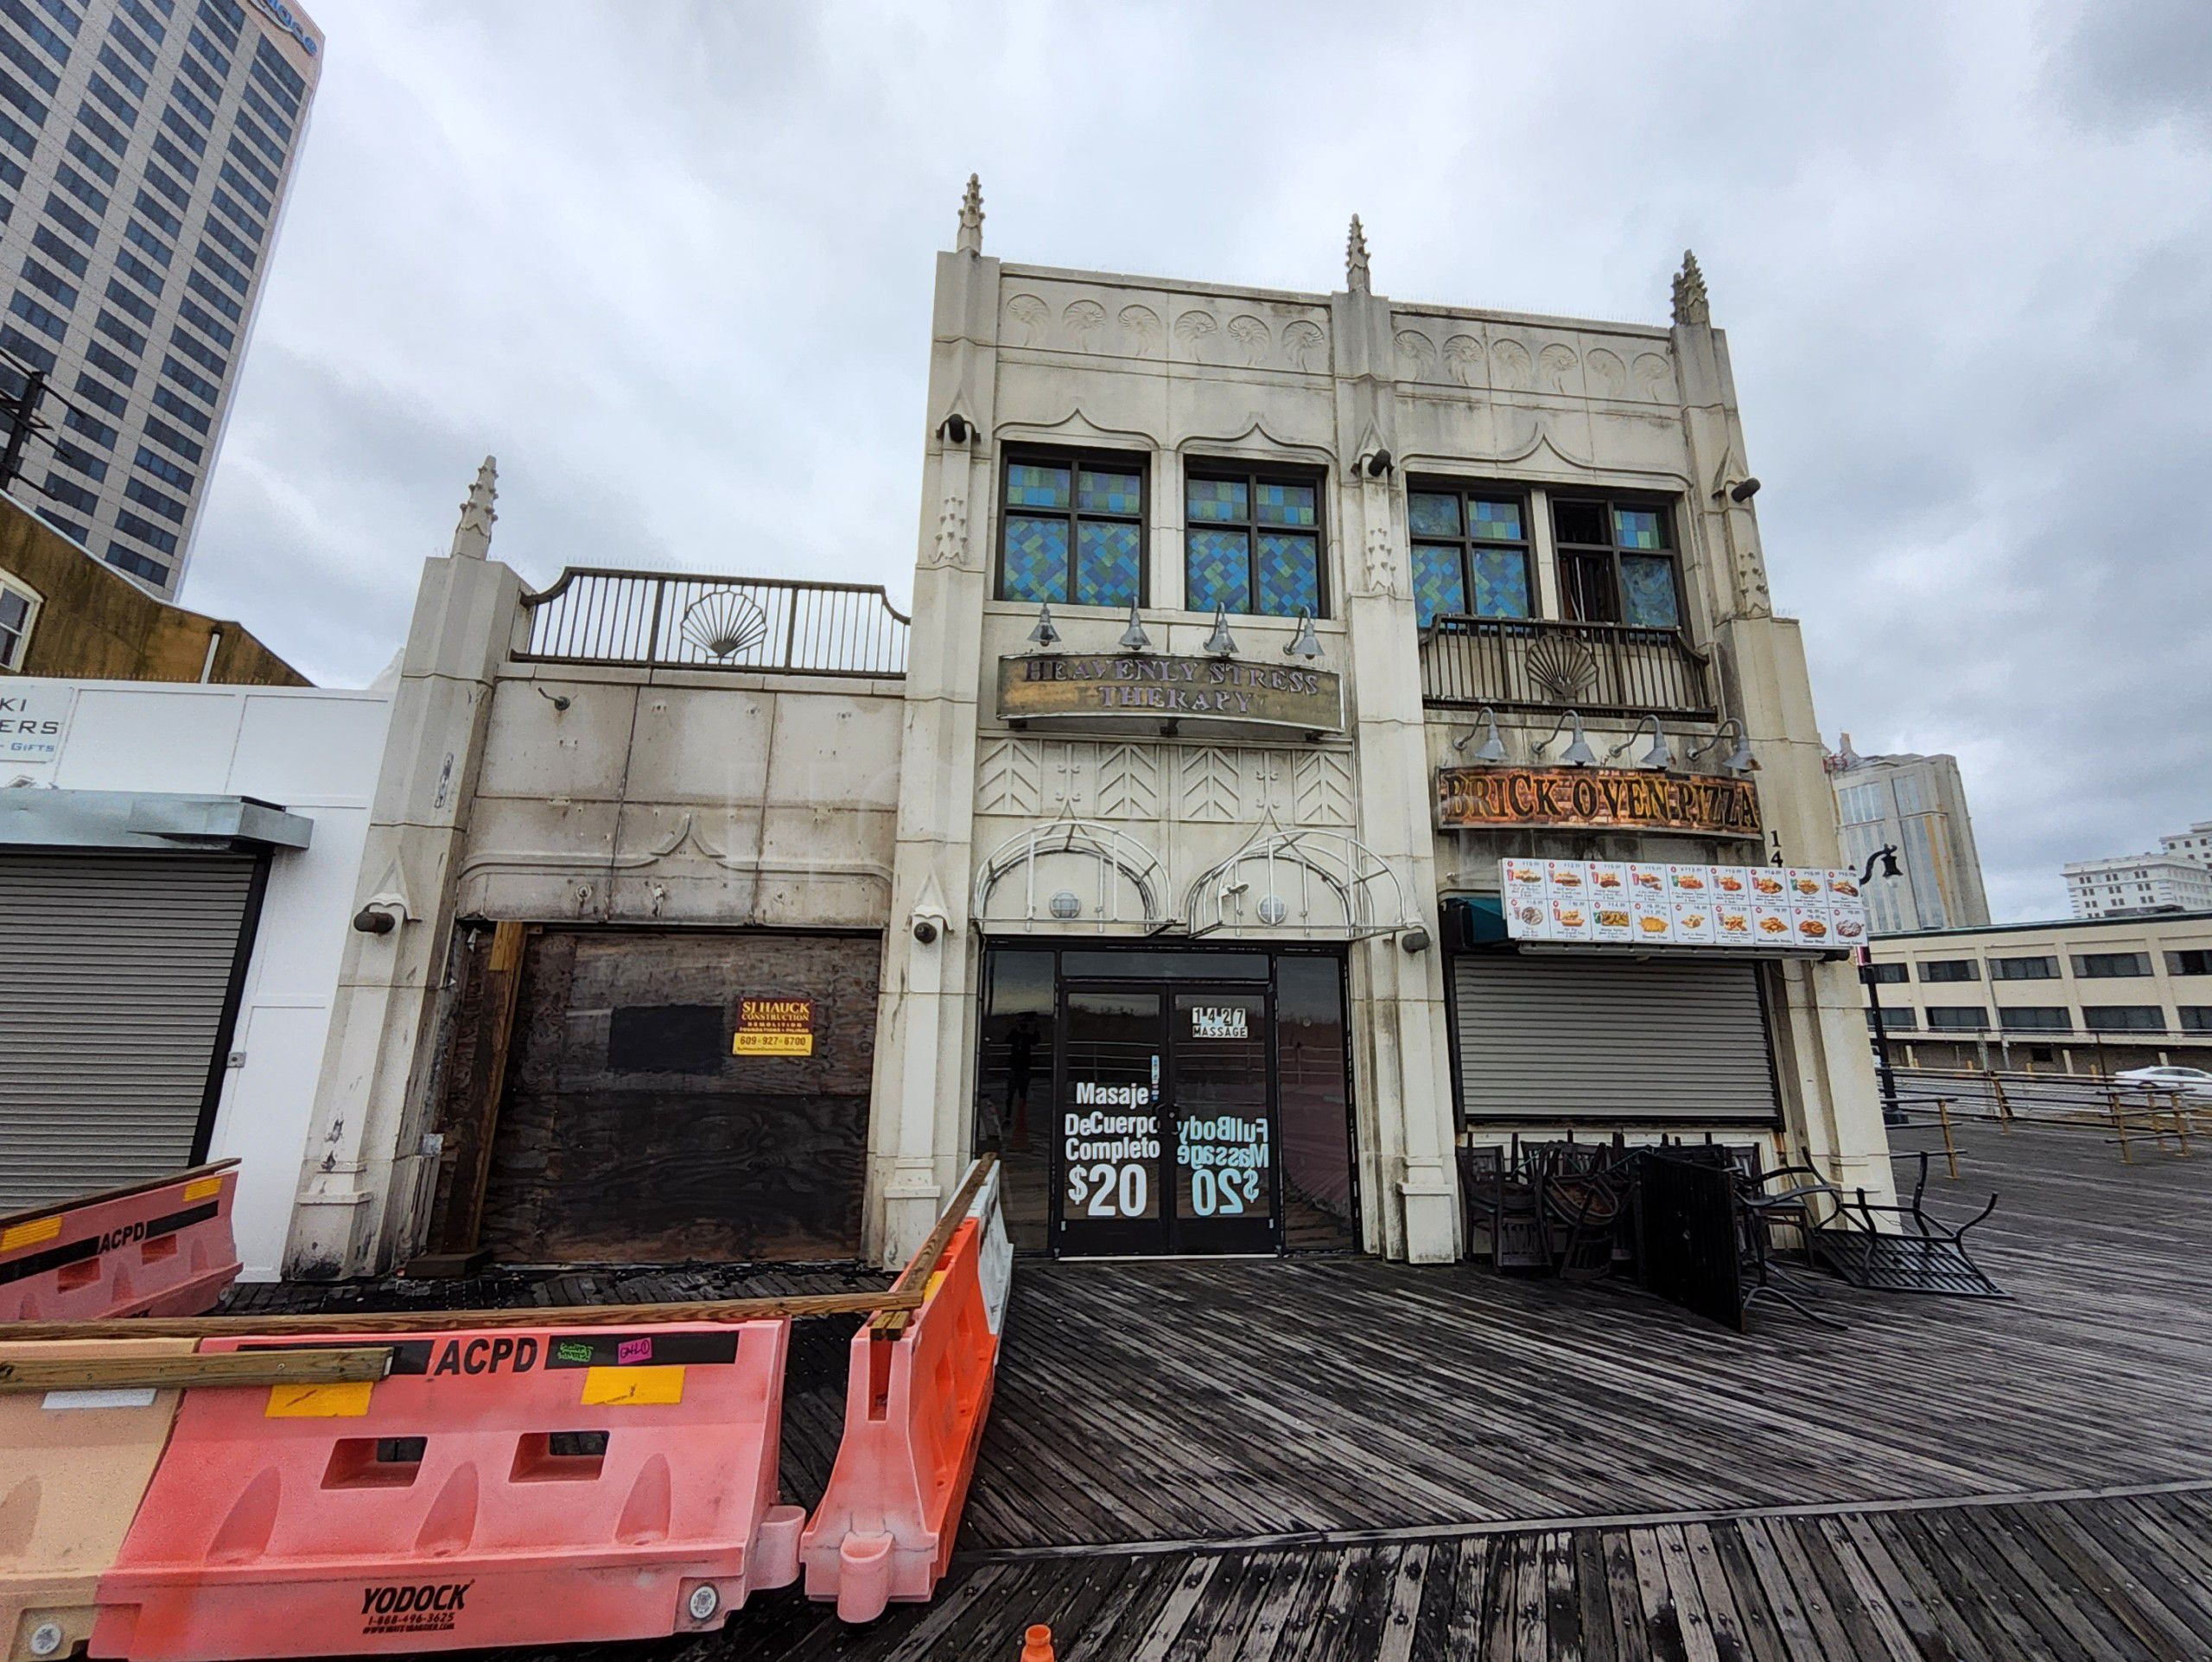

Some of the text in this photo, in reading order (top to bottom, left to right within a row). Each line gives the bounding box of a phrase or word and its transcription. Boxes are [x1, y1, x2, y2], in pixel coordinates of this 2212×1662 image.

[1025, 659, 1319, 695] HEAVENLY STRESS
[1098, 685, 1252, 713] THERAPY
[1446, 773, 1760, 830] BRICK OVEN PIZZA
[742, 1001, 810, 1014] SJ HAUCK
[1193, 1008, 1244, 1025] 1427
[1193, 1026, 1247, 1037] MASSAGE
[1076, 1082, 1149, 1110] Masaje
[1065, 1137, 1160, 1164] Completo
[1068, 1163, 1147, 1217] $20
[99, 1221, 145, 1255] ACPD
[434, 1337, 537, 1376] ACPD
[361, 1583, 472, 1614] YODOCK
